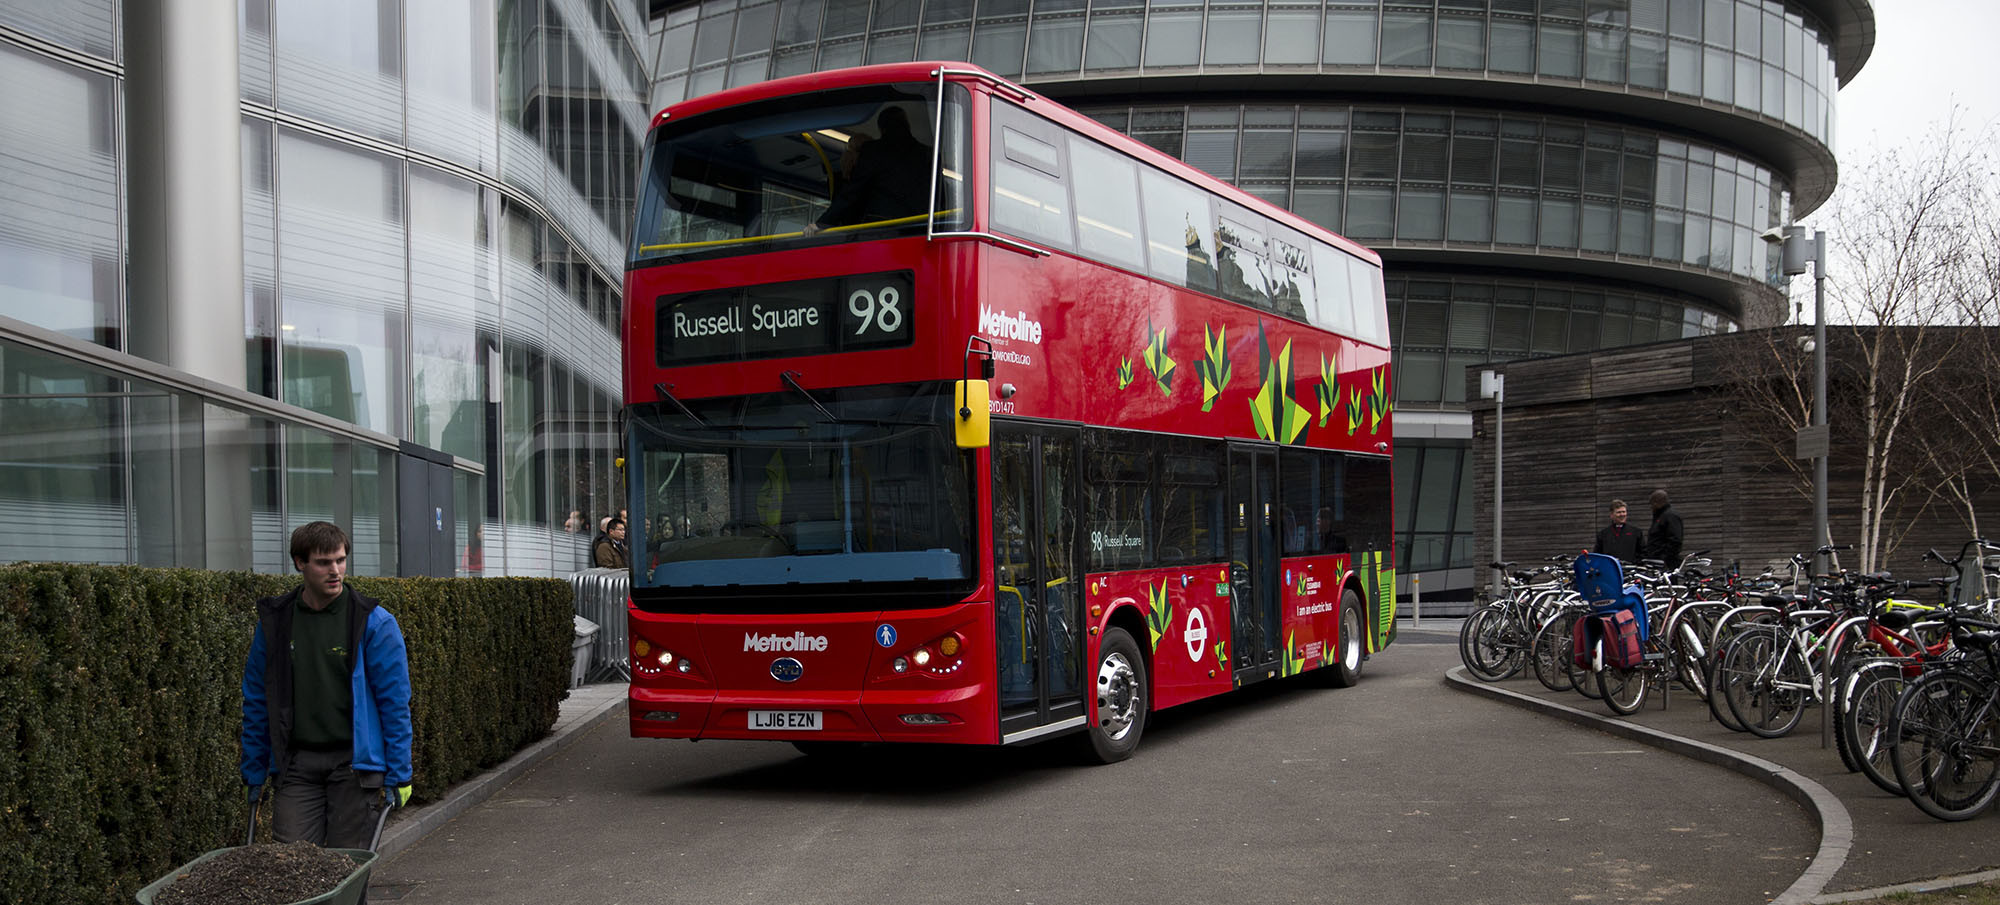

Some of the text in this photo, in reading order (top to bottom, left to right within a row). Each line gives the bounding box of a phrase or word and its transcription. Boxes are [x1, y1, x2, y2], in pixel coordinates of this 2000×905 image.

[674, 286, 902, 338] Russell Square 98
[978, 302, 1042, 344] Metroline
[989, 400, 1015, 414] BYD1472
[1091, 531, 1142, 551] 98 Russell Square
[1100, 576, 1107, 587] AC
[1311, 602, 1325, 614] electric
[1325, 601, 1333, 612] bus
[743, 631, 828, 653] Metroline
[755, 712, 815, 728] LJ16 EZN
